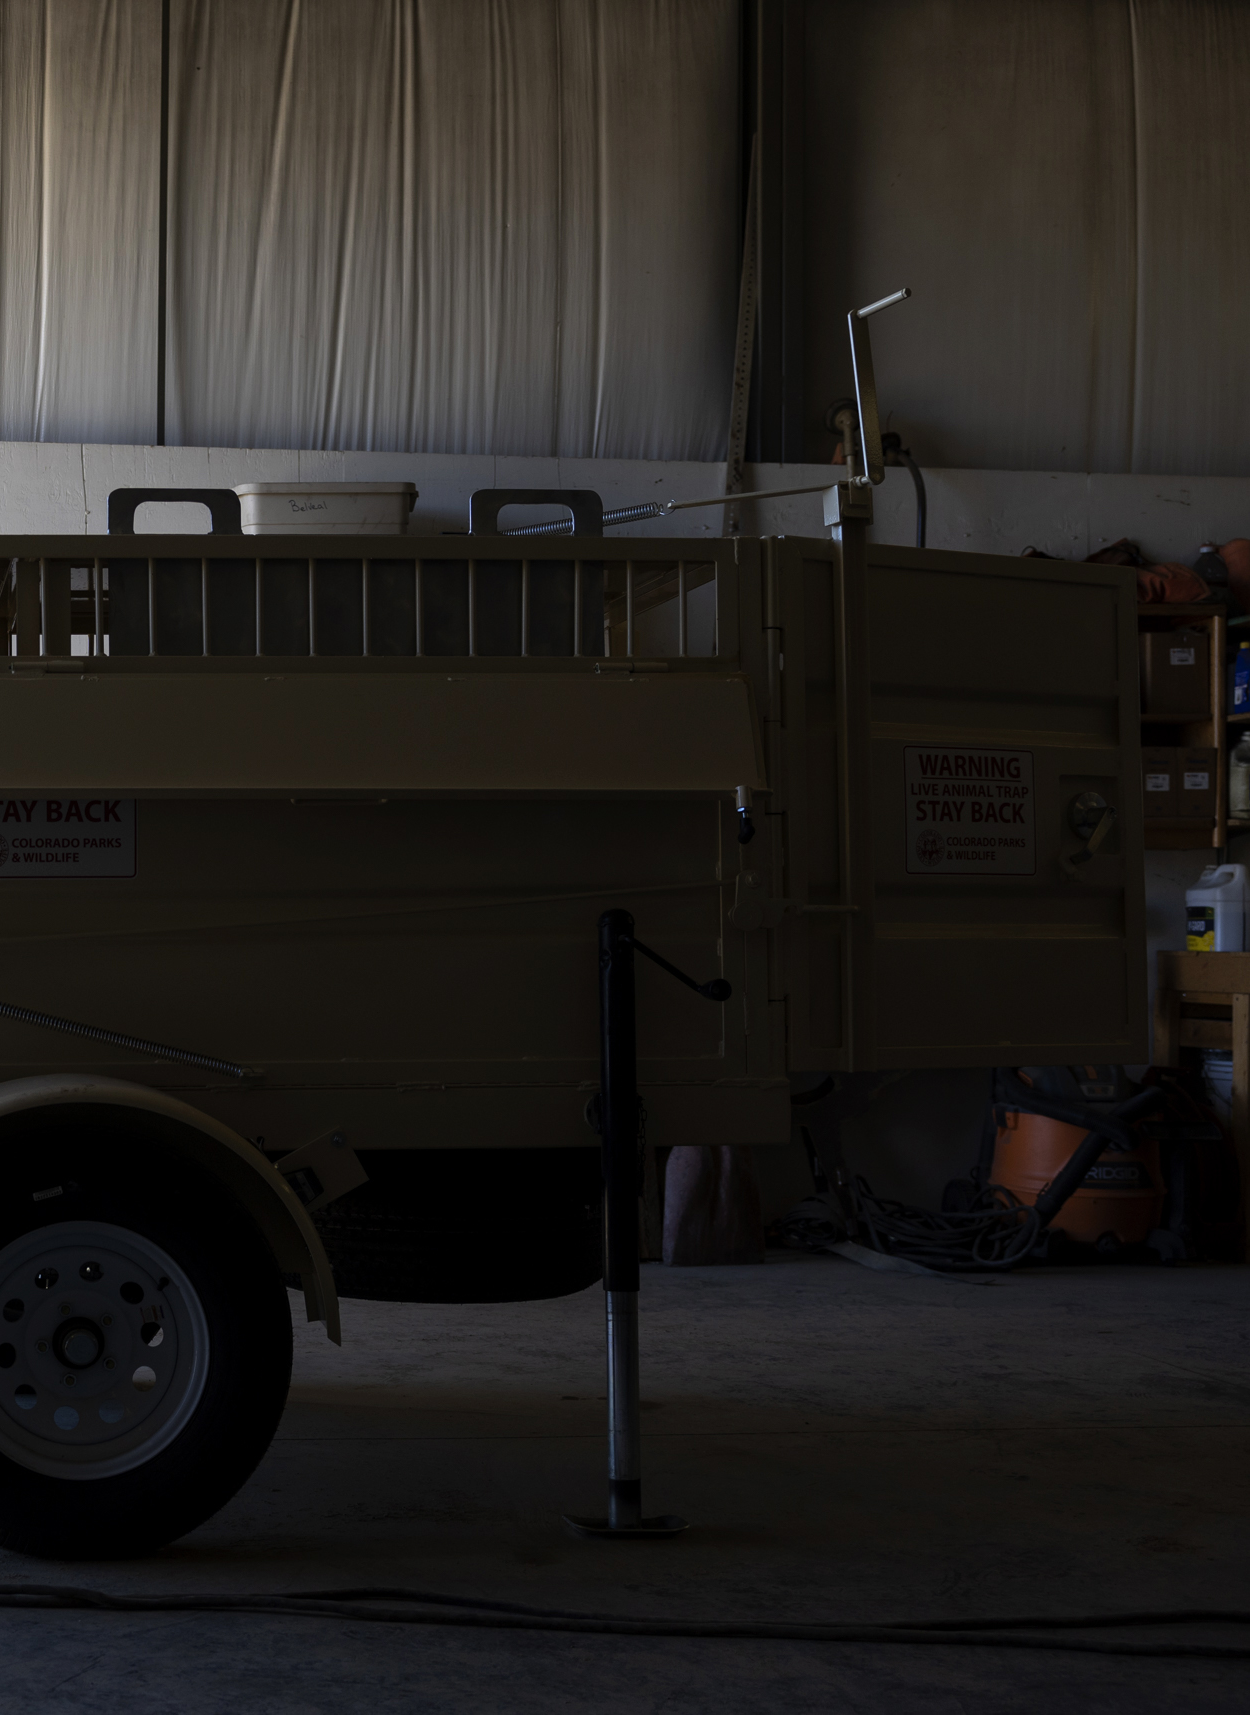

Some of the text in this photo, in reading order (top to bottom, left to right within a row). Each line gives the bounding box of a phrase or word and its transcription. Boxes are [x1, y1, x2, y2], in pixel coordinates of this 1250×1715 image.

[918, 754, 1021, 779] WARNING
[911, 783, 1029, 799] LIVE ANIMAL TRAP
[46, 800, 122, 823] BACK
[916, 800, 1025, 824] STAY BACK
[11, 837, 122, 849] COLORADO PARKS
[946, 836, 1026, 848] COLORADO PARKS
[12, 852, 80, 863] & WILDLIFE
[946, 850, 953, 860] &
[955, 851, 996, 861] WILDLIFE
[1085, 1166, 1140, 1180] RIDGID
